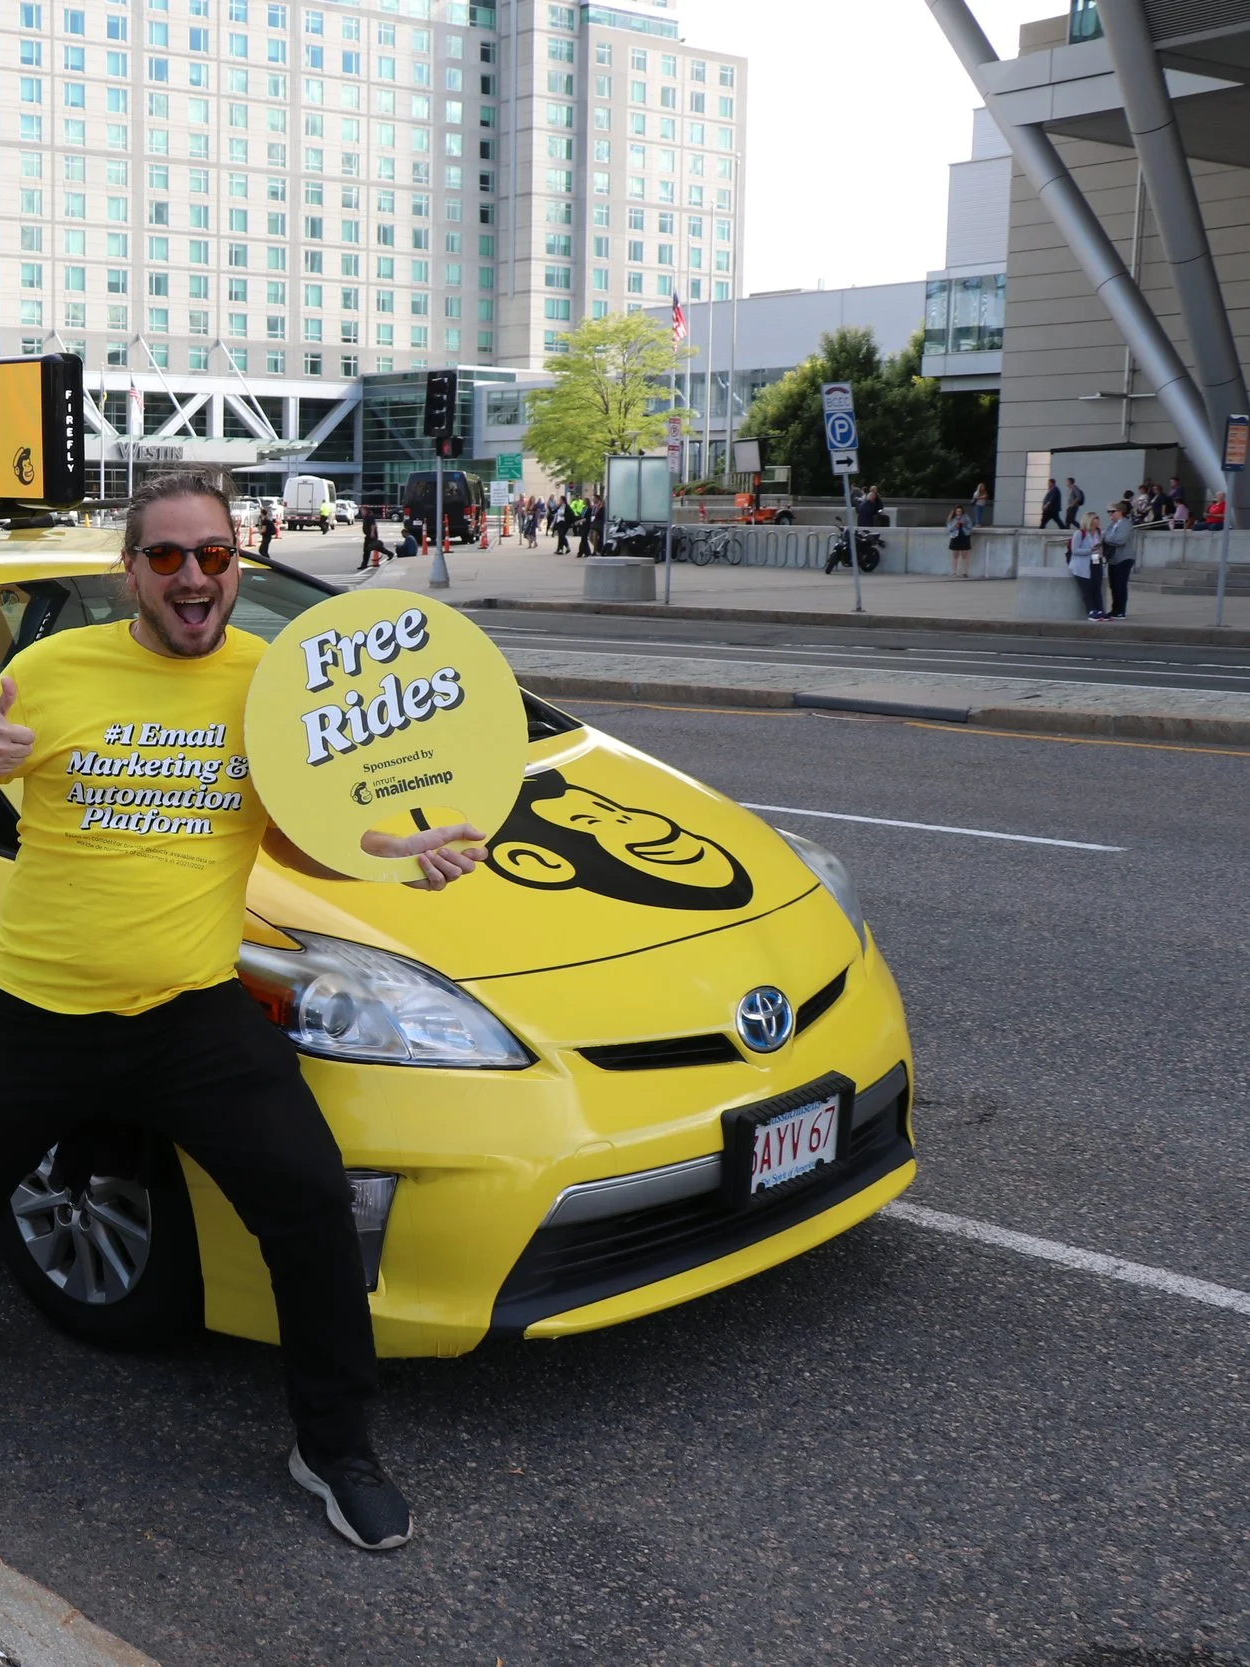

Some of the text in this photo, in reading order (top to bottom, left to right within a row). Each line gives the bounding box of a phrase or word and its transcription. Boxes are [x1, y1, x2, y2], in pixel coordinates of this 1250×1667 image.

[65, 390, 75, 473] FIREFLY
[300, 607, 431, 693] Free
[300, 666, 465, 767] Rides
[103, 723, 226, 748] #1 Email
[66, 750, 249, 784] Marketing &
[362, 749, 435, 773] Sponsored by
[66, 781, 242, 811] Automation
[374, 769, 454, 799] mailchimp
[79, 806, 213, 835] Platform
[808, 1105, 836, 1153] 67
